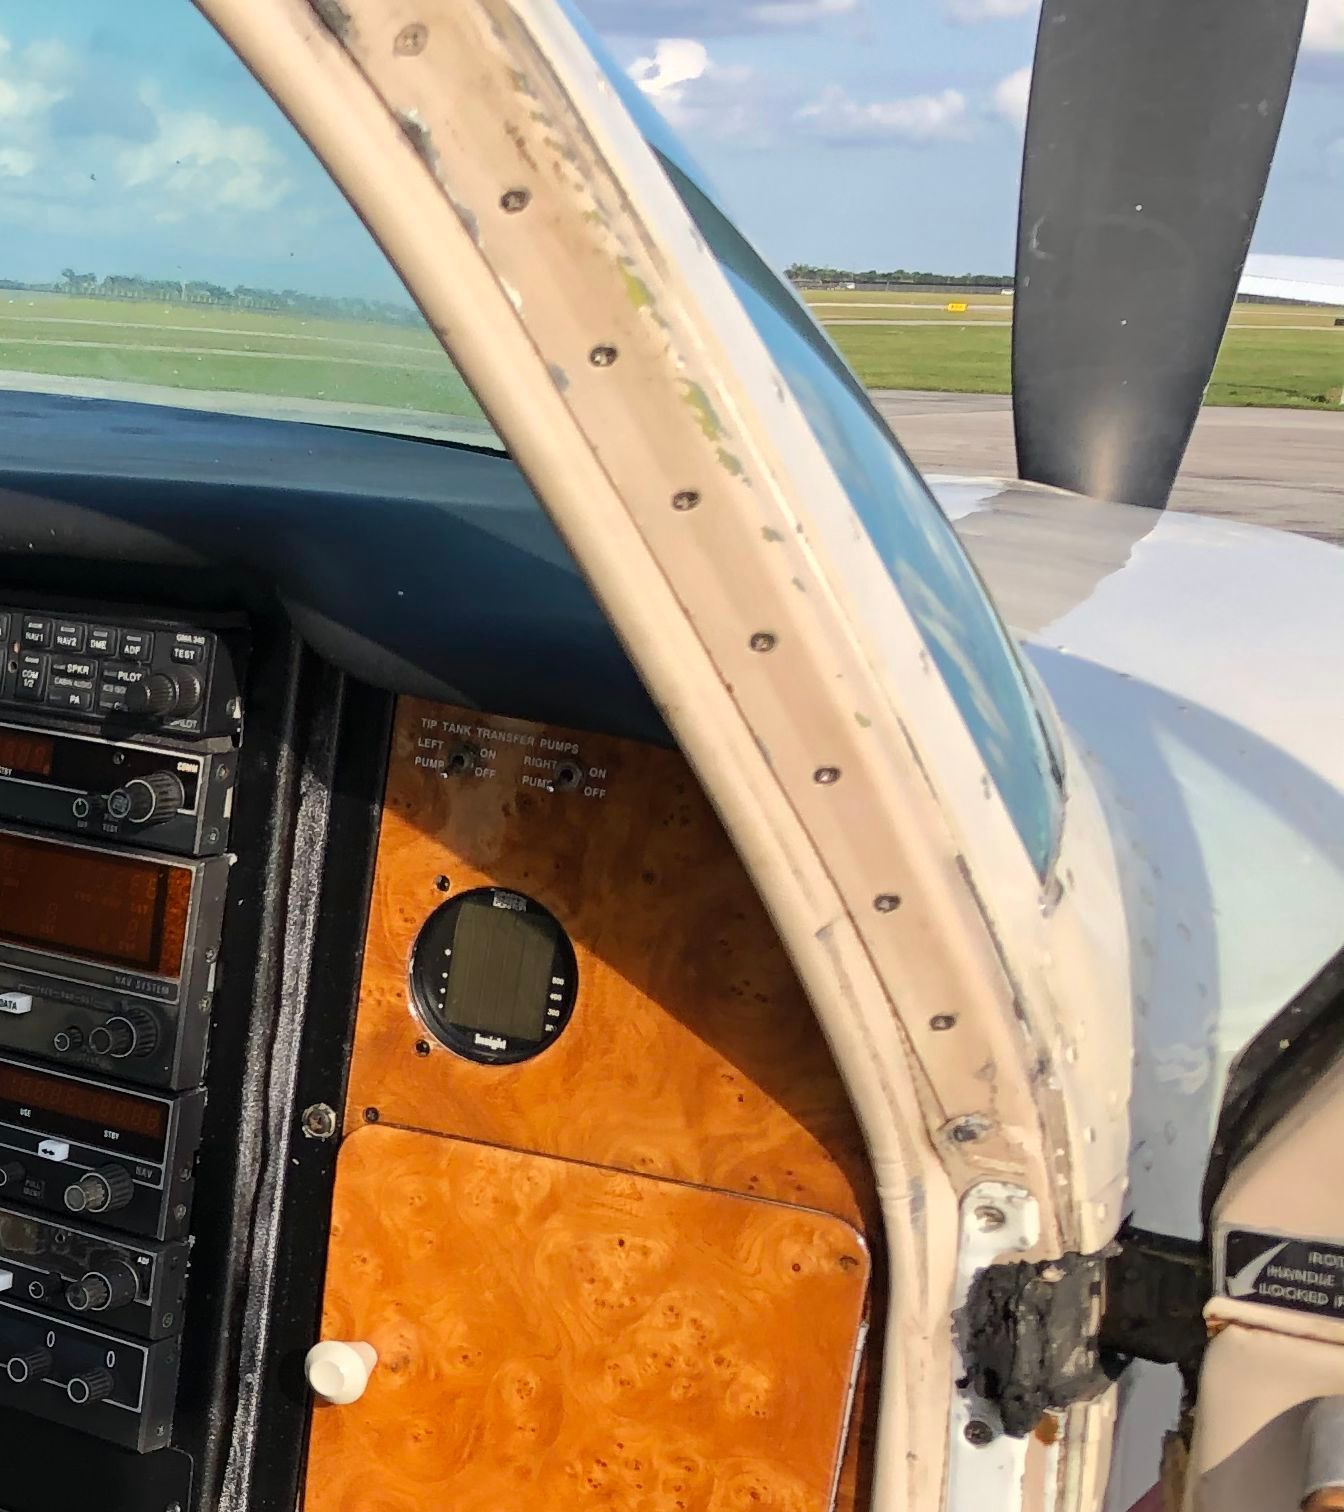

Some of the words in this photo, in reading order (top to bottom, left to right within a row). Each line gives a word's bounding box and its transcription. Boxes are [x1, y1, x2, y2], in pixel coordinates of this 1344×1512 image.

[25, 631, 44, 642] NAV1
[56, 636, 76, 647] NAV2
[124, 645, 141, 655] ADF
[174, 648, 195, 660] TEST
[22, 670, 39, 680] COM
[67, 663, 89, 675] SPKR
[118, 671, 142, 682] PILOT
[421, 718, 437, 729] TIP
[442, 722, 471, 736] TANK
[477, 727, 535, 746] TRANSFER
[540, 738, 579, 754] PUMPS
[418, 737, 444, 750] LEFT
[480, 748, 496, 760] ON
[415, 757, 445, 770] PUMP
[524, 756, 557, 770] RIGHT
[475, 767, 496, 779] OFF
[589, 768, 607, 779] ON
[584, 787, 607, 799] OFF
[1267, 1265, 1335, 1286] HANDLE
[1259, 1283, 1329, 1306] LOCKED
